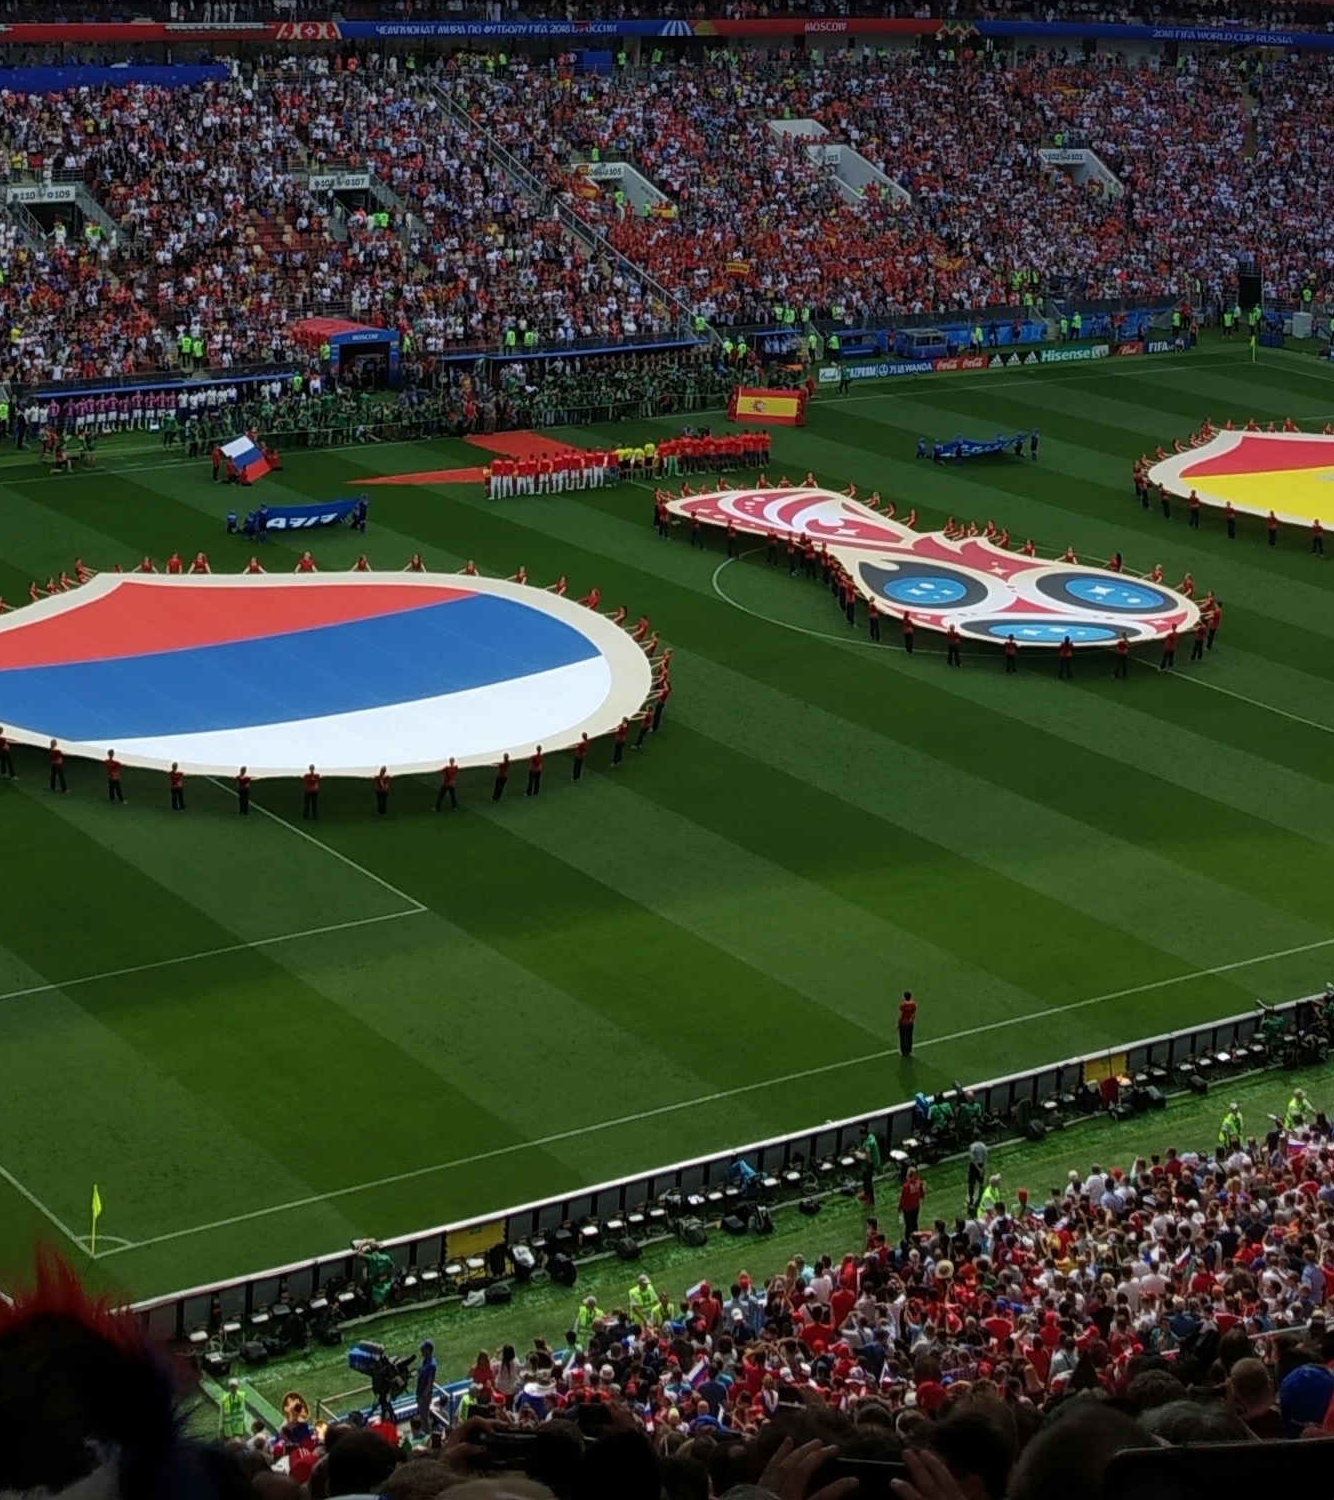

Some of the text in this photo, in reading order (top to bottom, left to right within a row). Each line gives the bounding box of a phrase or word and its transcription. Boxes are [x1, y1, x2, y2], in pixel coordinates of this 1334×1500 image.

[376, 25, 435, 35] ЧЕМПИОНАТ
[437, 25, 465, 35] МИРА
[468, 25, 481, 35] ПО
[483, 24, 526, 35] ФУТБОЛУ
[528, 24, 547, 34] FIFA
[549, 24, 570, 34] 2018
[579, 24, 617, 34] ОССИИ
[804, 22, 847, 32] MOSCOW
[1152, 29, 1293, 44] 2018 FIFA WORLD CUP RUSSIA
[351, 178, 365, 186] 107
[20, 190, 70, 200] 110 109
[1042, 349, 1090, 362] Hisense
